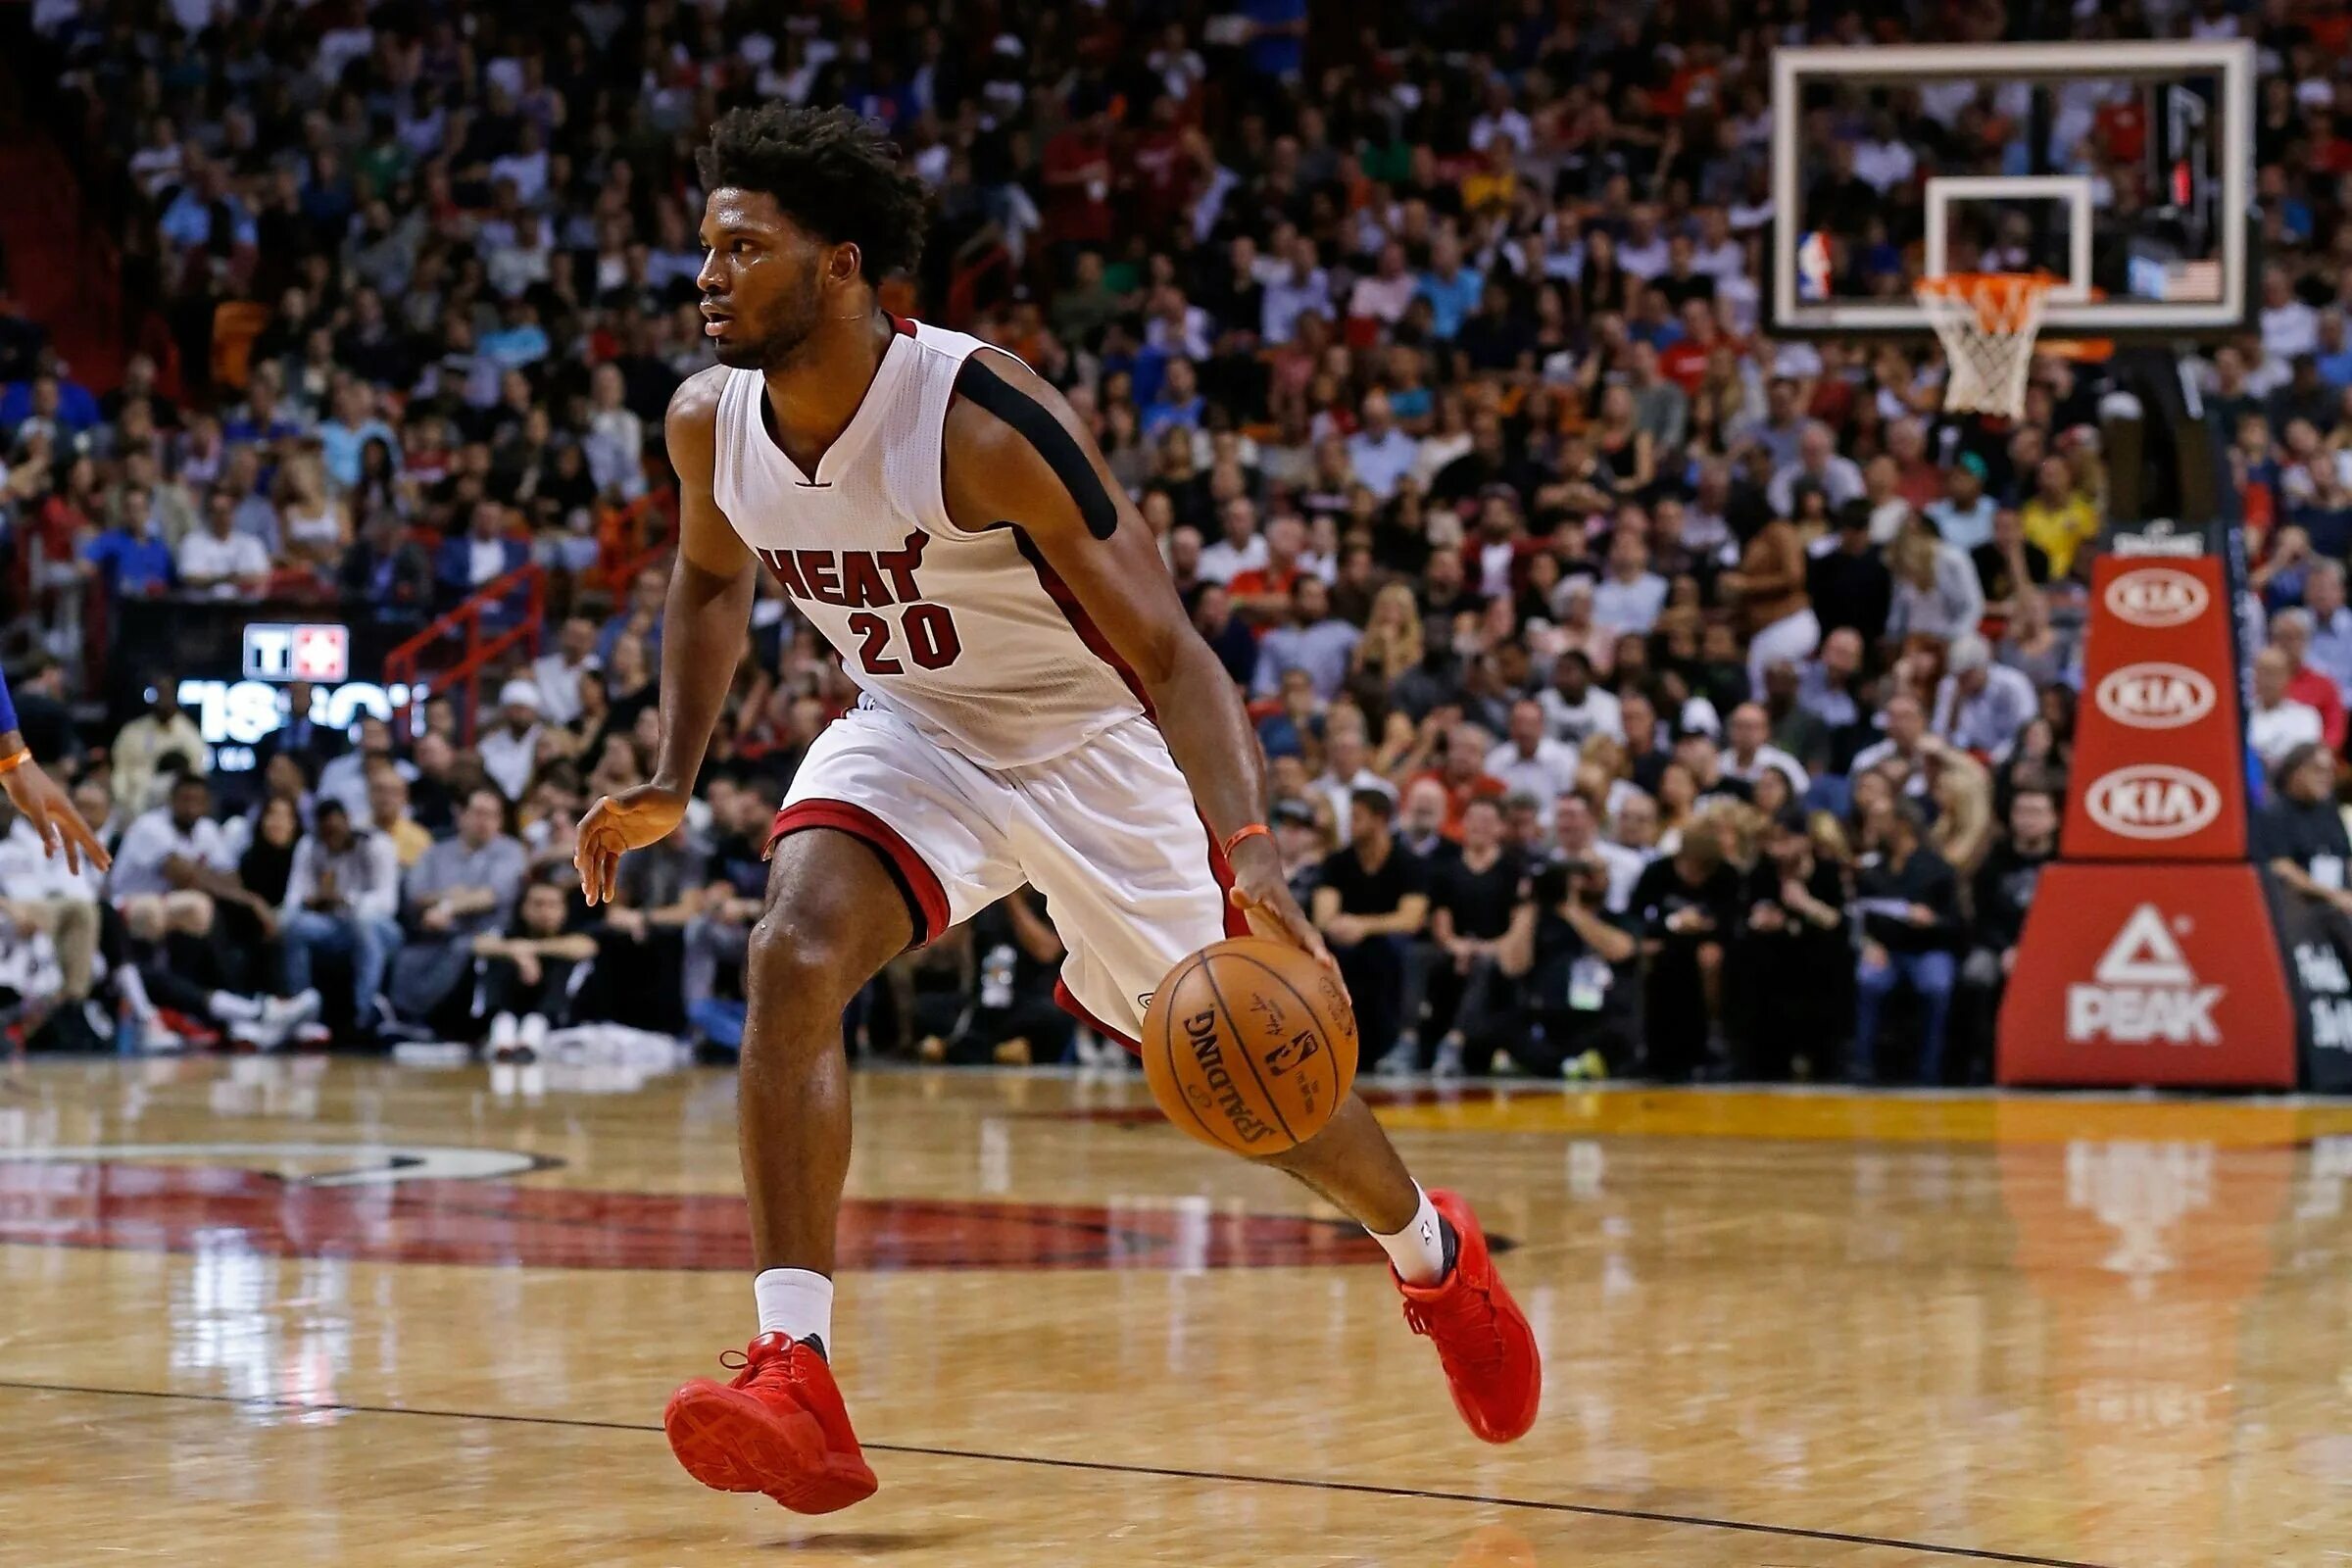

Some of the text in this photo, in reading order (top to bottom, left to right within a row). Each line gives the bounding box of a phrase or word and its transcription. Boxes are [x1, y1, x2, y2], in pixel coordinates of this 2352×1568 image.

[756, 526, 930, 609] HEAT
[2124, 584, 2193, 611] KIA
[847, 604, 962, 675] 20
[2117, 680, 2196, 710] KIA
[2108, 784, 2198, 819] KIA
[2065, 984, 2227, 1045] PEAK
[1183, 1008, 1276, 1144] SPALDING
